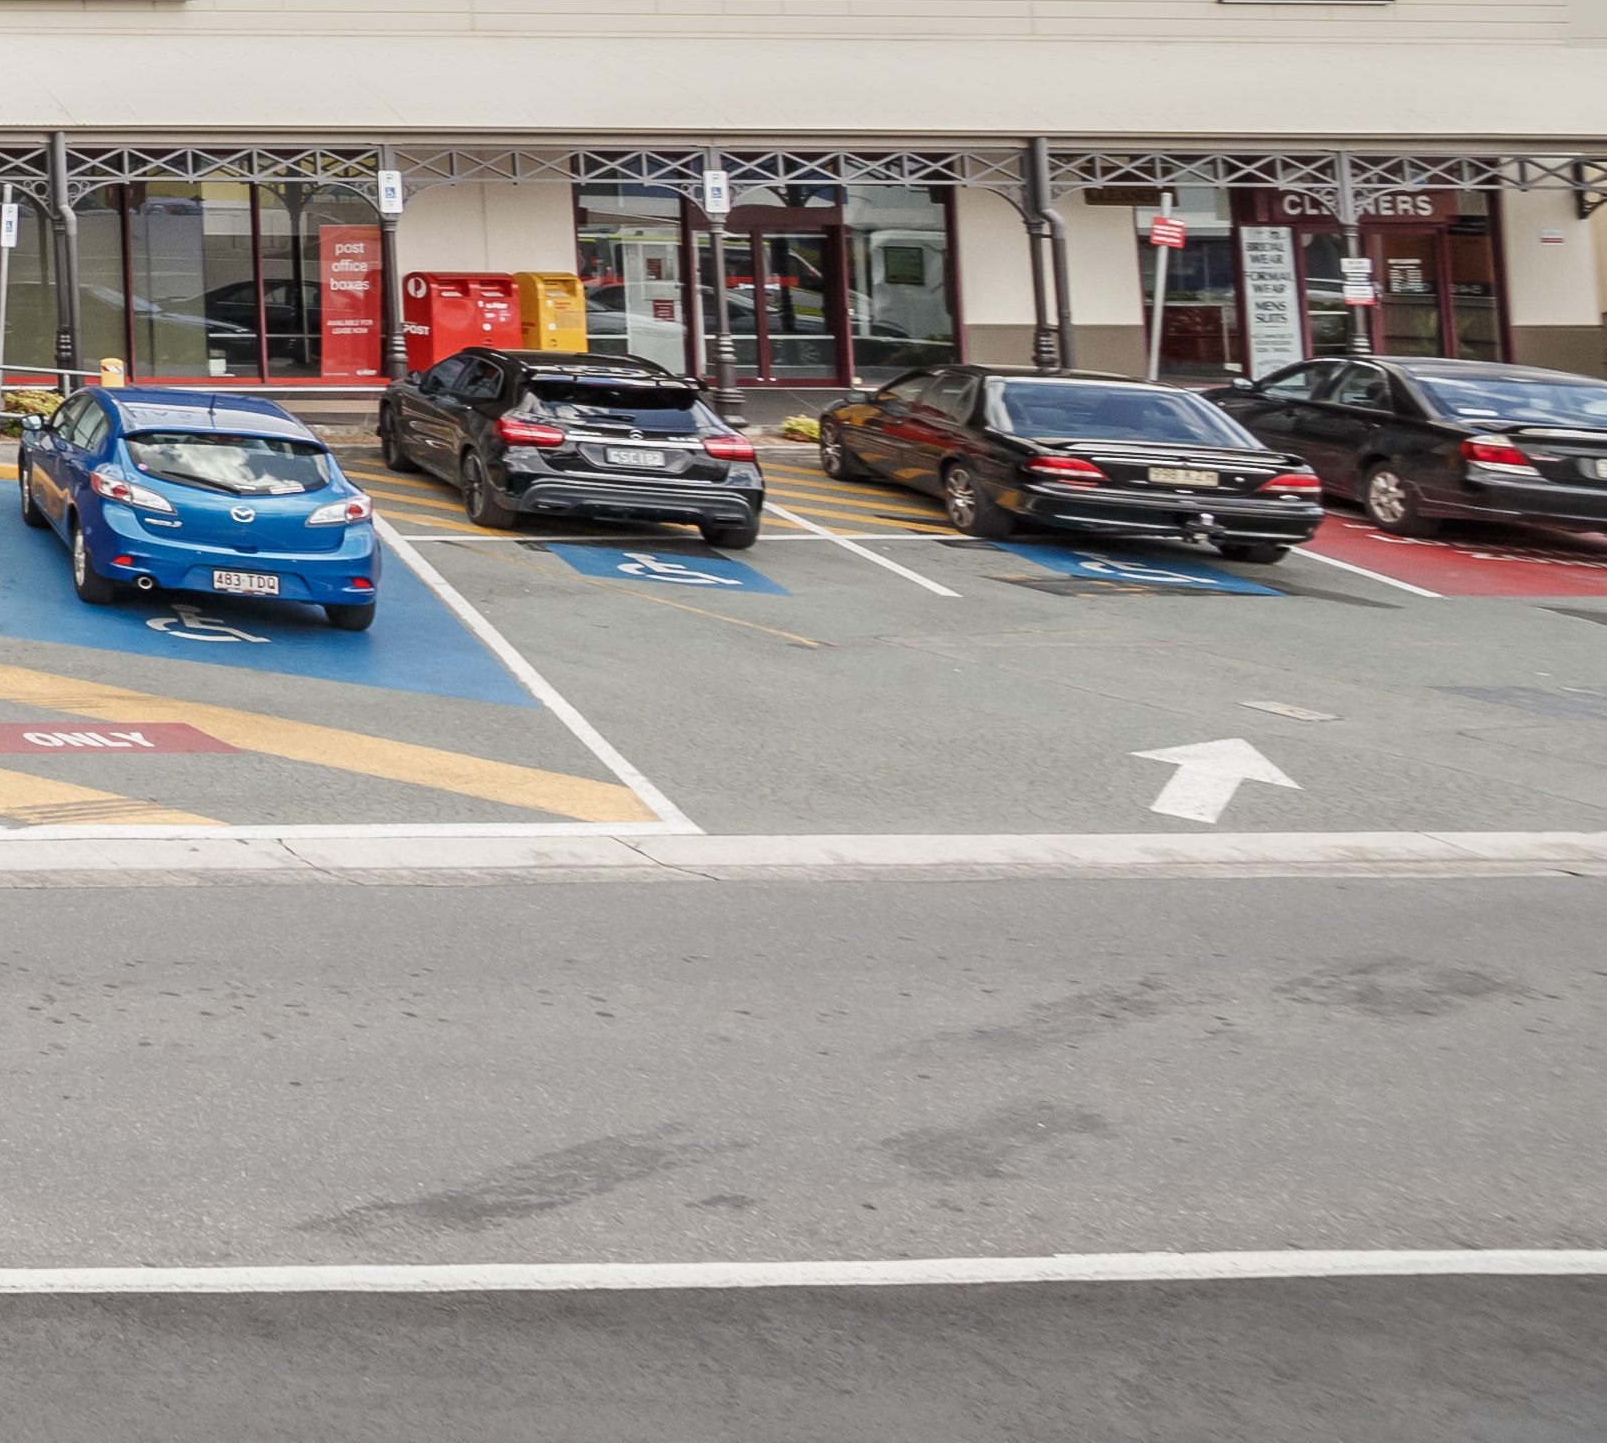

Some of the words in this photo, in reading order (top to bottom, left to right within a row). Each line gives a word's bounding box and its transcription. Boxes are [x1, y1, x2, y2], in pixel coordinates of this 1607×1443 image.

[1282, 194, 1433, 216] CLNERS
[335, 242, 365, 256] post
[331, 259, 368, 272] office
[329, 277, 370, 291] boxes
[1254, 301, 1287, 312] MENS
[403, 324, 430, 336] POST
[22, 730, 156, 749] ONLY
